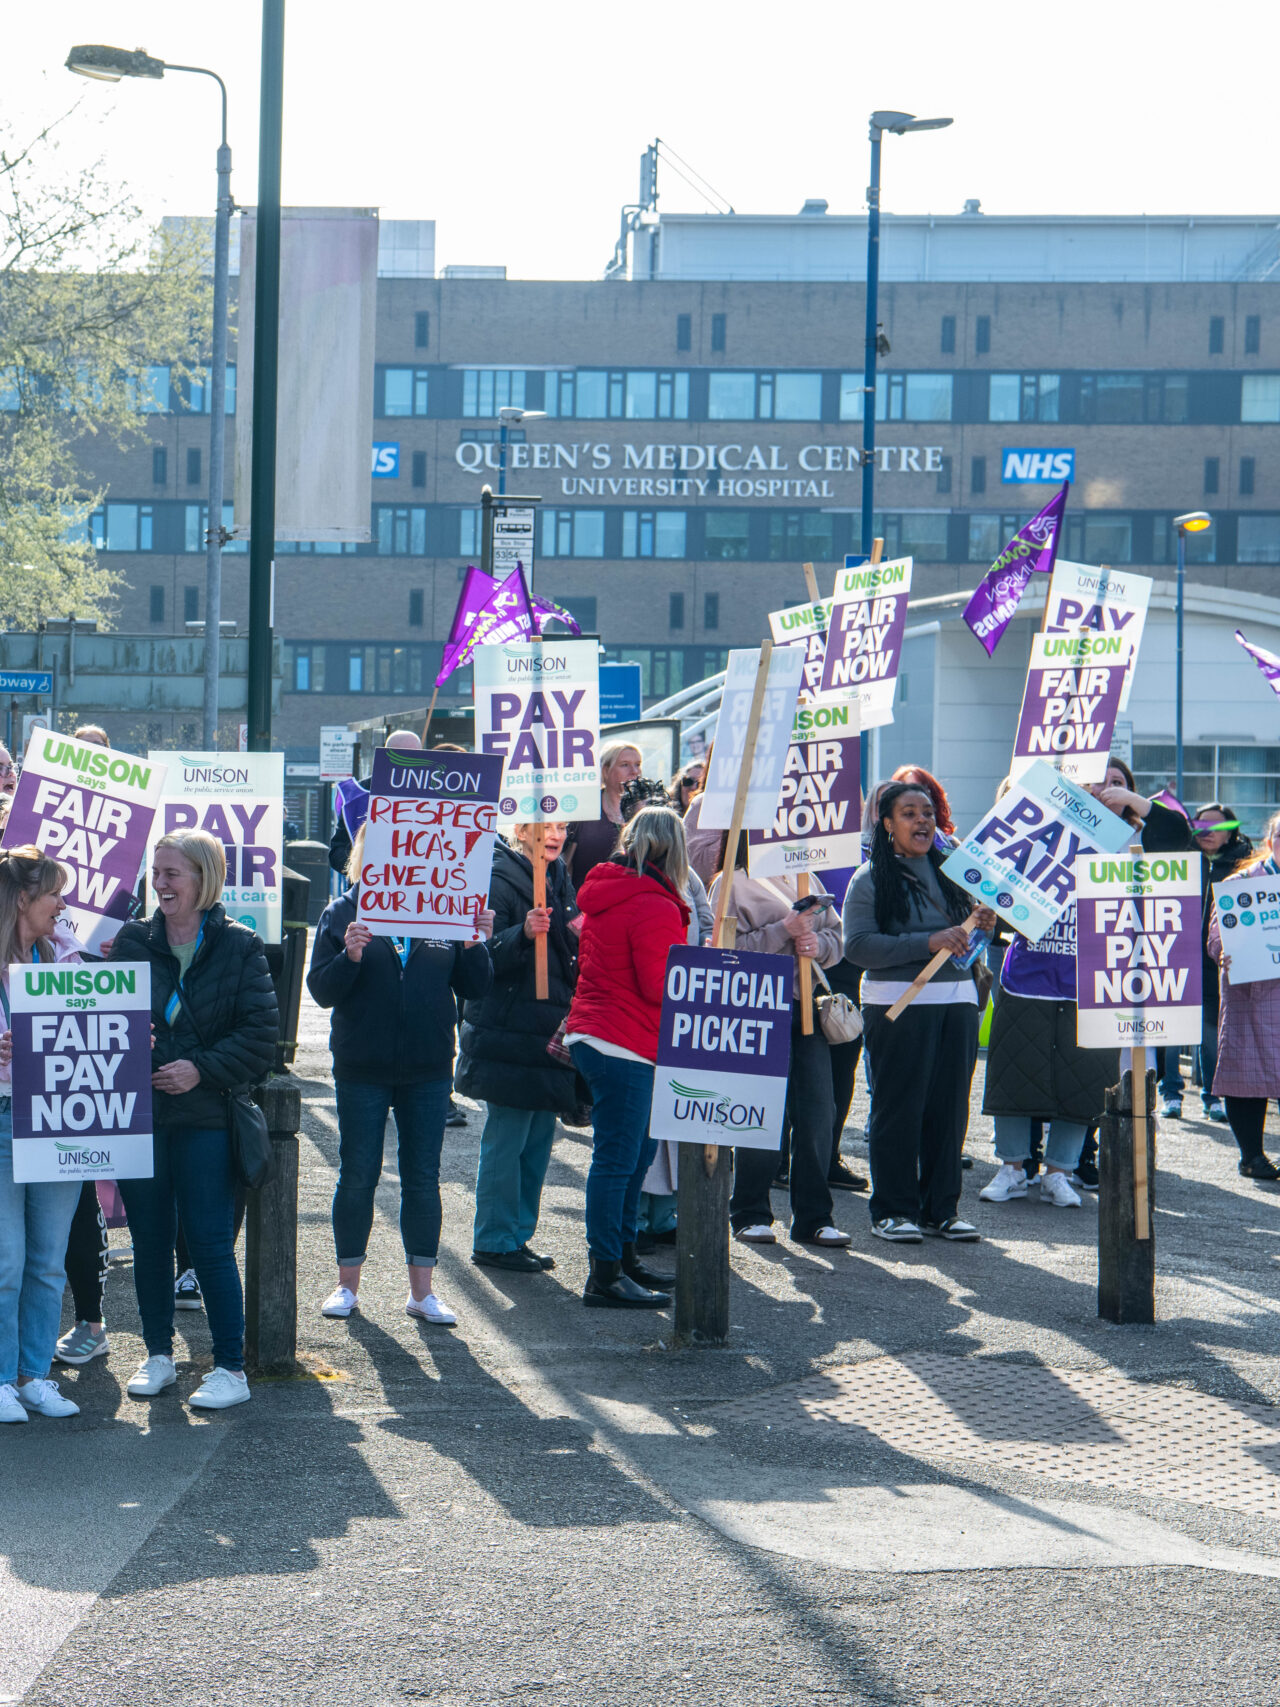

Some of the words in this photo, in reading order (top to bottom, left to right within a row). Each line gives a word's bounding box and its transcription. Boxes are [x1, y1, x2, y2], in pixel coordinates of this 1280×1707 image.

[455, 442, 611, 474] QUEEN'S
[622, 444, 788, 472] MEDICAL
[798, 445, 944, 473] CENTRE
[1004, 453, 1073, 479] NHS
[561, 477, 709, 497] UNIVERSITY
[717, 479, 834, 498] HOSPITAL
[495, 551, 506, 559] 53
[509, 551, 519, 559] 54
[843, 564, 905, 592] UNISON
[1077, 575, 1126, 595] UNISON
[839, 596, 897, 631] FAIR
[1056, 598, 1135, 632] PAY
[842, 624, 891, 658] PAY
[1043, 637, 1122, 657] UNISON
[507, 657, 566, 673] UNISON
[831, 649, 893, 687] NOW
[1070, 657, 1091, 667] says
[1039, 668, 1111, 698] FAIR
[490, 689, 586, 732] PAY
[1042, 695, 1102, 725] PAY
[482, 729, 595, 770] FAIR
[792, 729, 816, 741] says
[1027, 722, 1105, 752] NOW
[43, 738, 152, 790] UNISON
[783, 741, 843, 774] AIR
[76, 773, 107, 790] says
[183, 768, 249, 784] UNISON
[195, 786, 212, 795] public
[213, 786, 234, 794] service
[235, 786, 254, 794] union
[390, 767, 481, 793] UNISON
[506, 770, 559, 787] patient
[569, 770, 597, 783] care
[777, 772, 838, 807] PAY
[32, 779, 132, 839] FAIR
[371, 796, 498, 833] RESPECT
[763, 800, 848, 839] NOW
[1050, 785, 1102, 828] UNISON
[165, 803, 269, 845] PAY
[1004, 797, 1099, 869] PAY
[35, 818, 118, 870] PAY
[784, 848, 827, 863] UNISON
[974, 816, 1076, 905] FAIR
[1089, 860, 1188, 883] UNISON
[361, 863, 426, 887] GIVE
[431, 866, 467, 891] US
[965, 841, 985, 858] for
[983, 853, 1030, 893] patient
[1030, 889, 1059, 916] care
[1125, 884, 1153, 895] says
[241, 890, 277, 902] care
[360, 890, 410, 912] OUR
[1095, 899, 1183, 934] FAIR
[1027, 940, 1077, 956] SERVICES
[1106, 934, 1178, 969] PAY
[25, 970, 136, 996] UNISON
[667, 965, 790, 1011] OFFICIAL
[1094, 968, 1189, 1004] NOW
[65, 998, 97, 1010] says
[31, 1014, 130, 1052] FAIR
[671, 1012, 774, 1056] PICKET
[1118, 1021, 1164, 1034] UNISON
[44, 1053, 124, 1092] PAY
[31, 1091, 137, 1132] NOW
[673, 1099, 765, 1126] UNISON
[58, 1150, 110, 1165] UNISON
